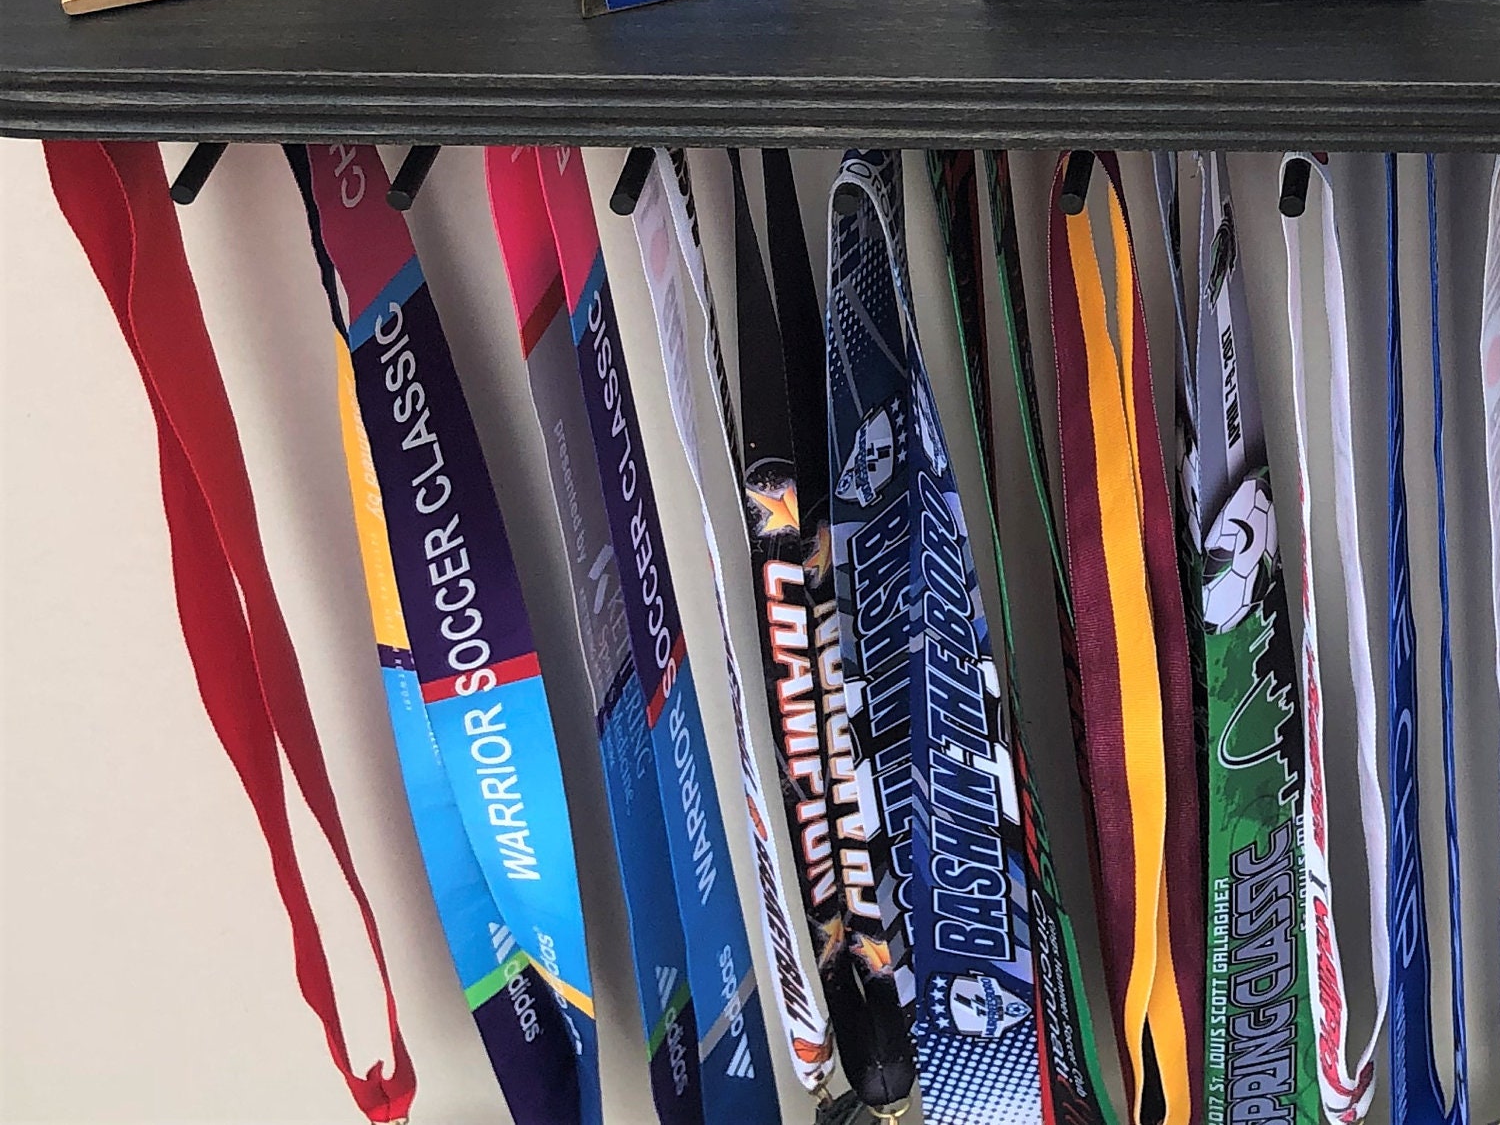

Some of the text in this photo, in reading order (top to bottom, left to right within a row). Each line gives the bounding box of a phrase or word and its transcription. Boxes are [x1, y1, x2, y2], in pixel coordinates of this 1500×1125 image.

[588, 290, 636, 501] CLASSIC
[374, 300, 541, 881] WARRIOR SOCCER CLASSIC
[630, 498, 676, 698] SOCCER
[918, 471, 978, 659] BORO
[763, 559, 837, 907] CHAMPION
[924, 635, 990, 759] THE
[668, 690, 717, 906] WARRIOR
[929, 748, 999, 826] IN
[930, 815, 1012, 962] BASH
[1212, 877, 1230, 972] GALLAGHER
[1228, 821, 1296, 1008] CLASSIC
[503, 960, 544, 1042] adidas
[663, 1006, 689, 1096] adidas
[719, 944, 745, 1037] adidas
[1031, 889, 1073, 1084] Cincinnati
[1209, 1029, 1226, 1068] LOUIS
[1211, 978, 1227, 1024] SCOTT
